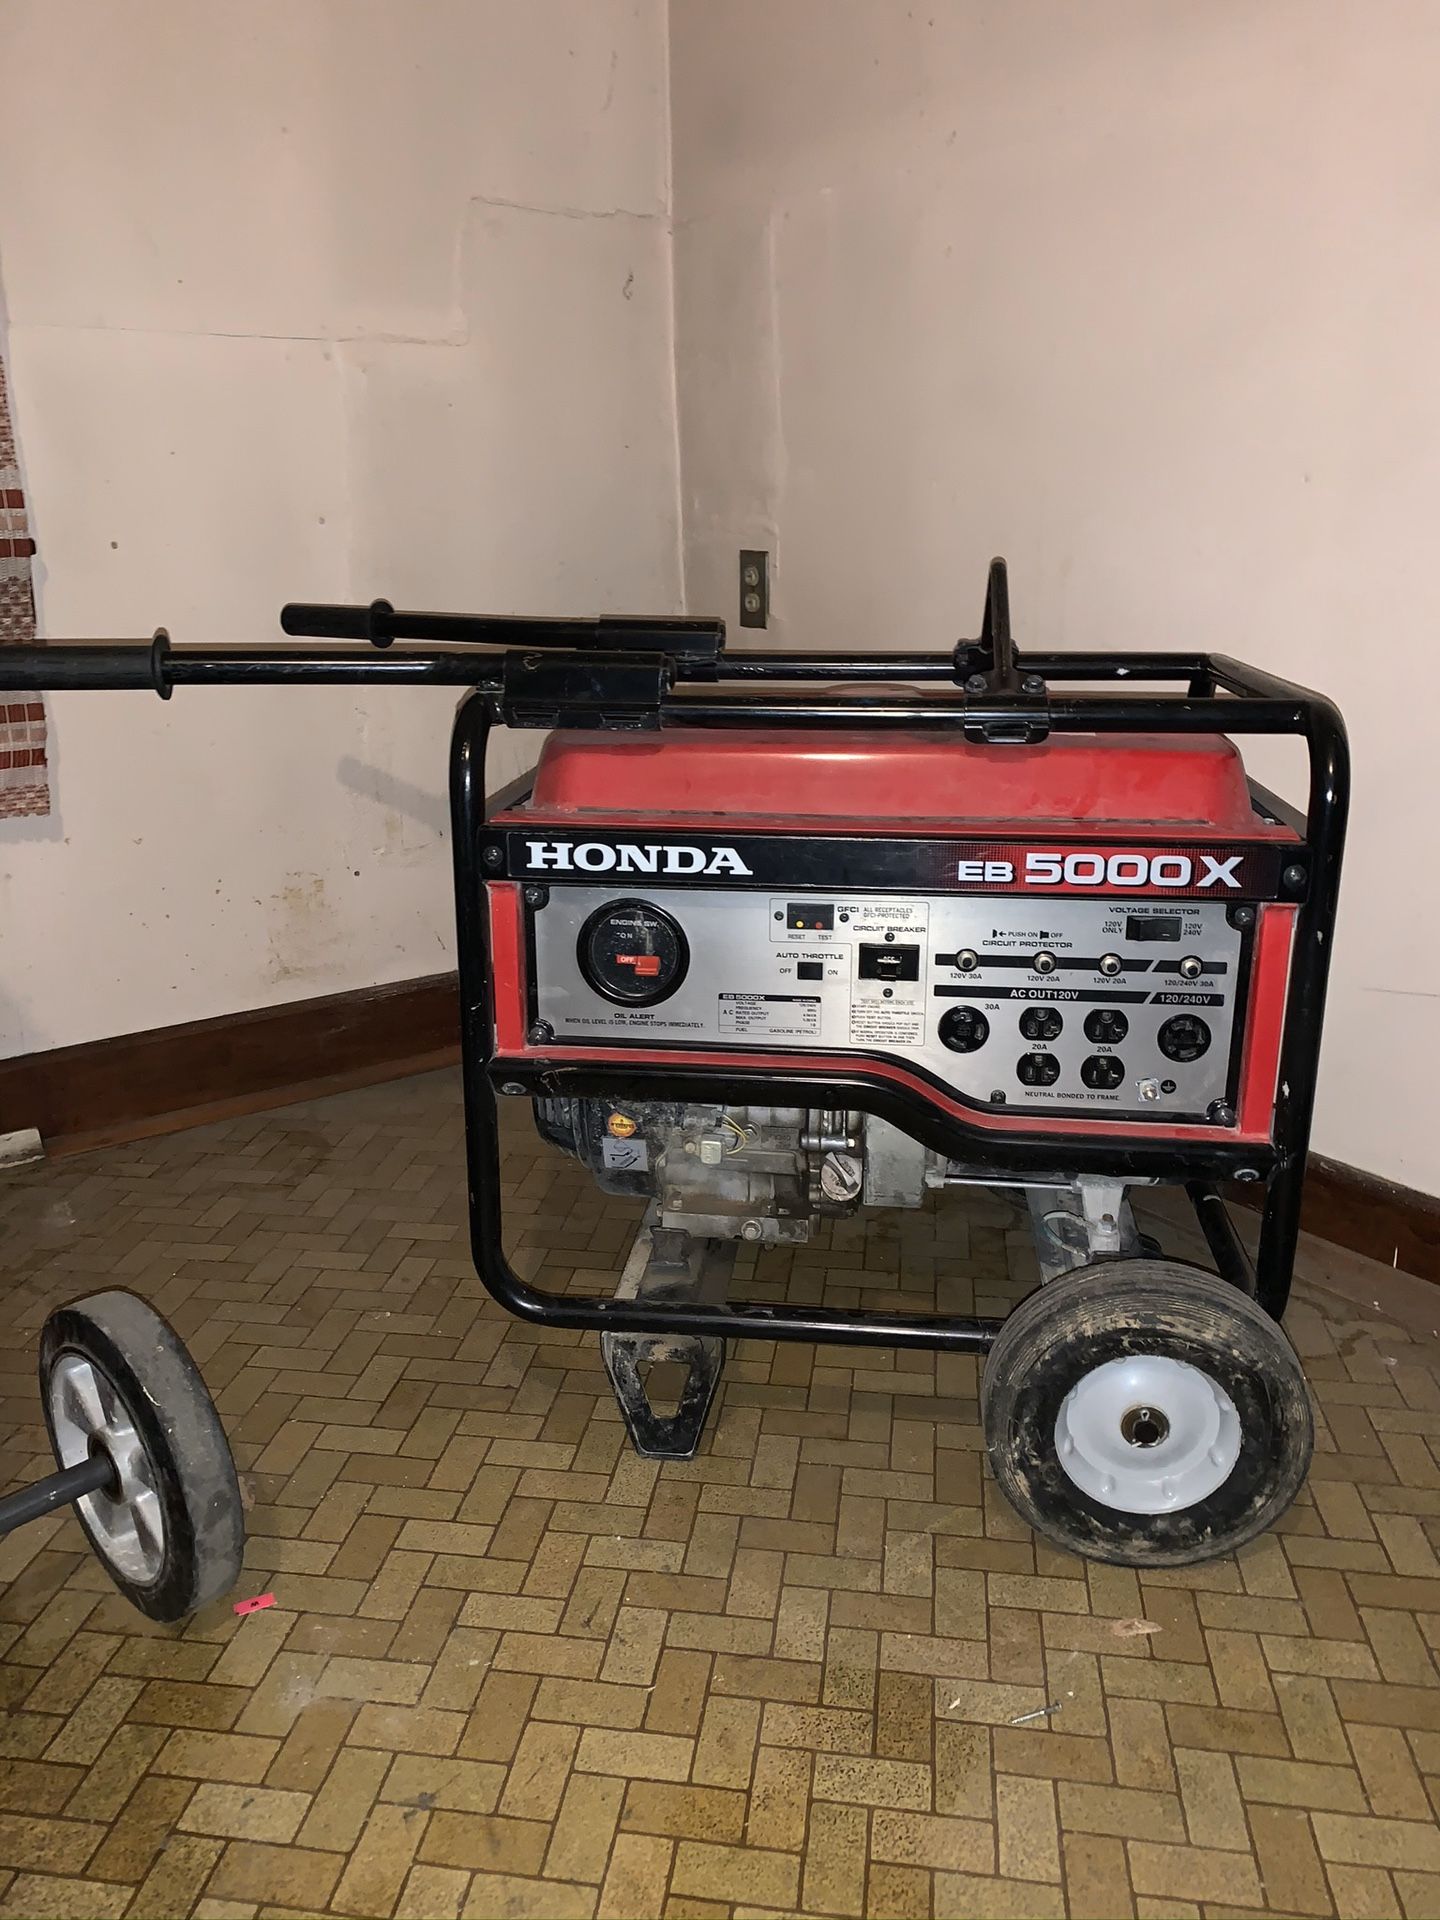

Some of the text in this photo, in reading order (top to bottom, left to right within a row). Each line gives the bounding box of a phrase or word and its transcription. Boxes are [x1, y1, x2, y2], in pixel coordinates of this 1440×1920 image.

[526, 841, 754, 875] HONDA
[958, 852, 1244, 888] EB 5000X
[1010, 990, 1026, 998] AC
[1160, 994, 1211, 1004] 120/240V
